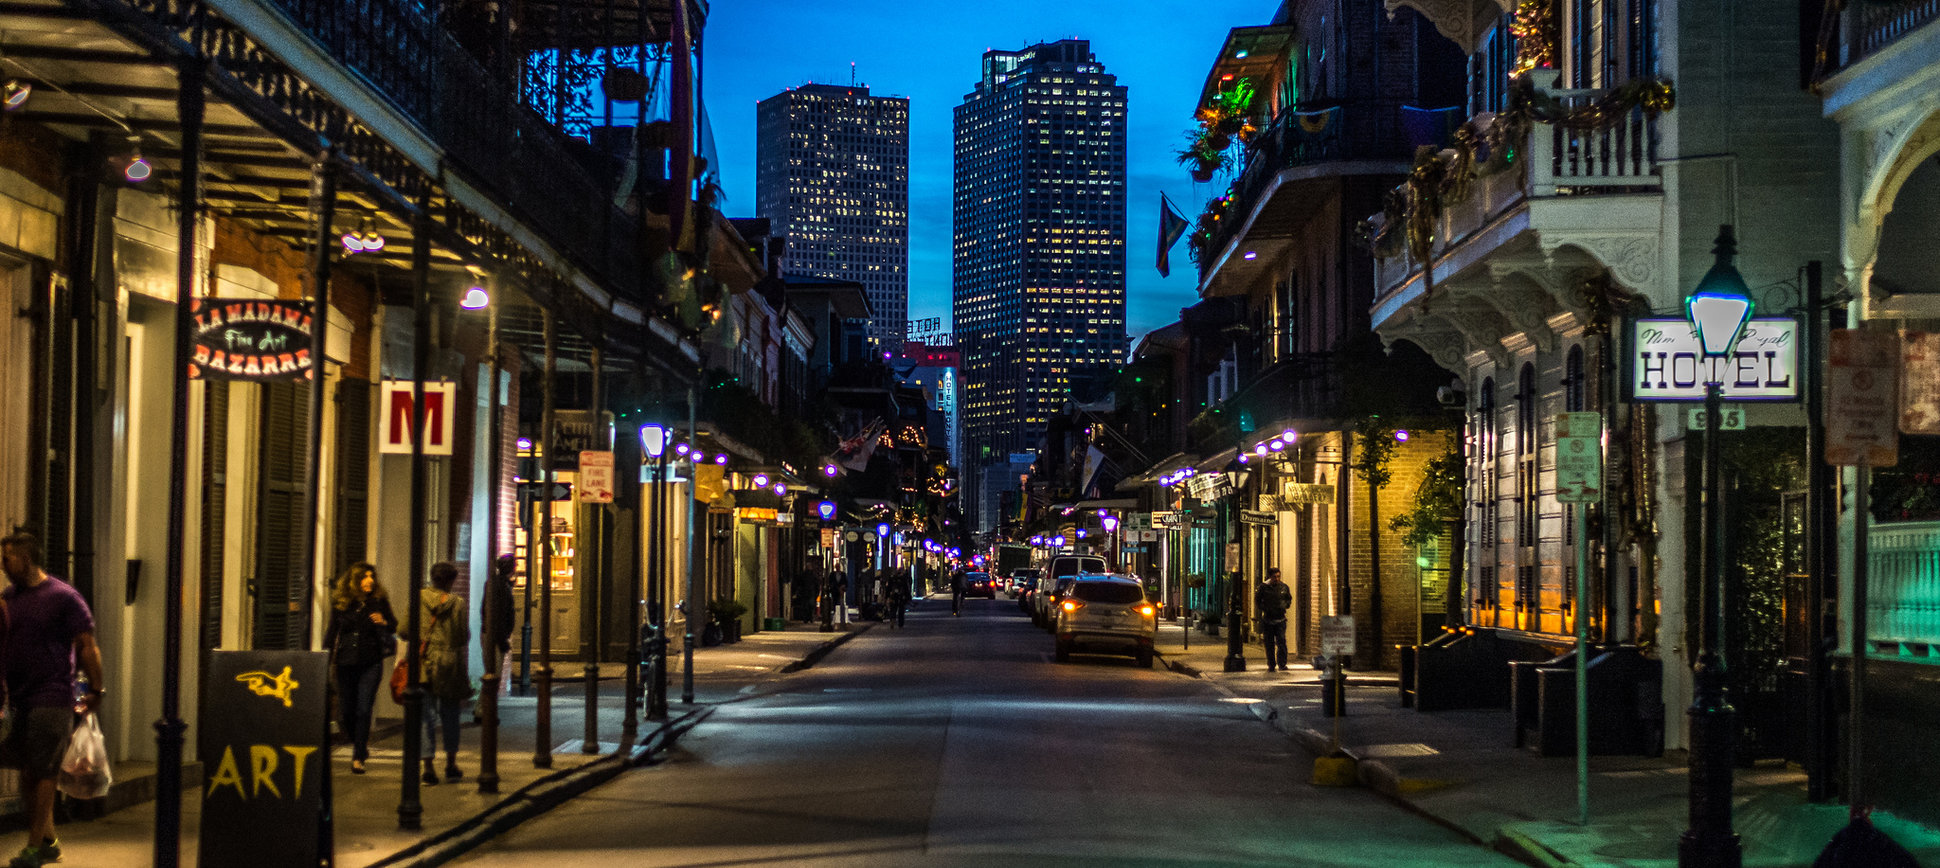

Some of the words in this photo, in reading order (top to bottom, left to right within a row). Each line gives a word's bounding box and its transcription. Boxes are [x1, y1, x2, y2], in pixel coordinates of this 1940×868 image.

[1641, 351, 1790, 388] HOTEL
[389, 391, 444, 445] M
[1695, 411, 1739, 428] 95
[586, 479, 606, 487] LANE
[588, 468, 605, 477] FIRE
[207, 744, 318, 800] ART
